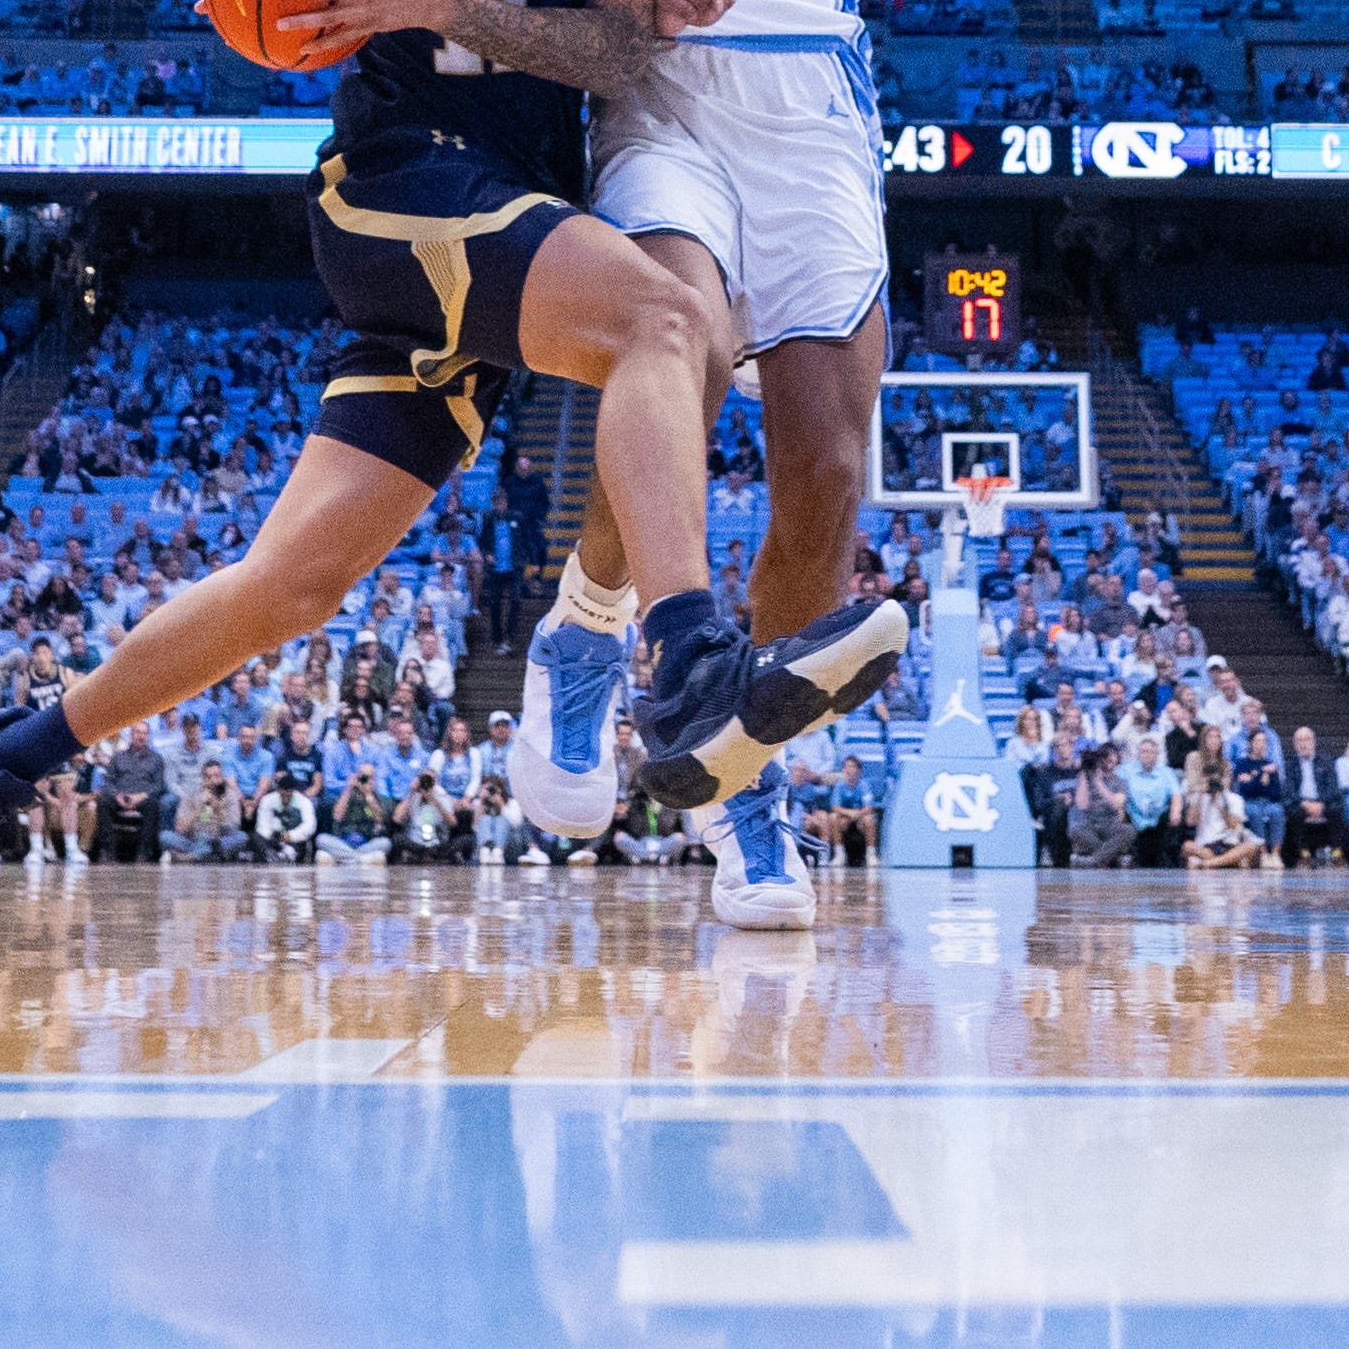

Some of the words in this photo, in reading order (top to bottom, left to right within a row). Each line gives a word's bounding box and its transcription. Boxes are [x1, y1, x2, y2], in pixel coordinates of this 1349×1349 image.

[74, 125, 148, 166] SMITH
[156, 125, 243, 166] CENTER
[1001, 125, 1051, 174] 20
[947, 268, 1006, 298] 10:42
[962, 298, 1001, 340] 17
